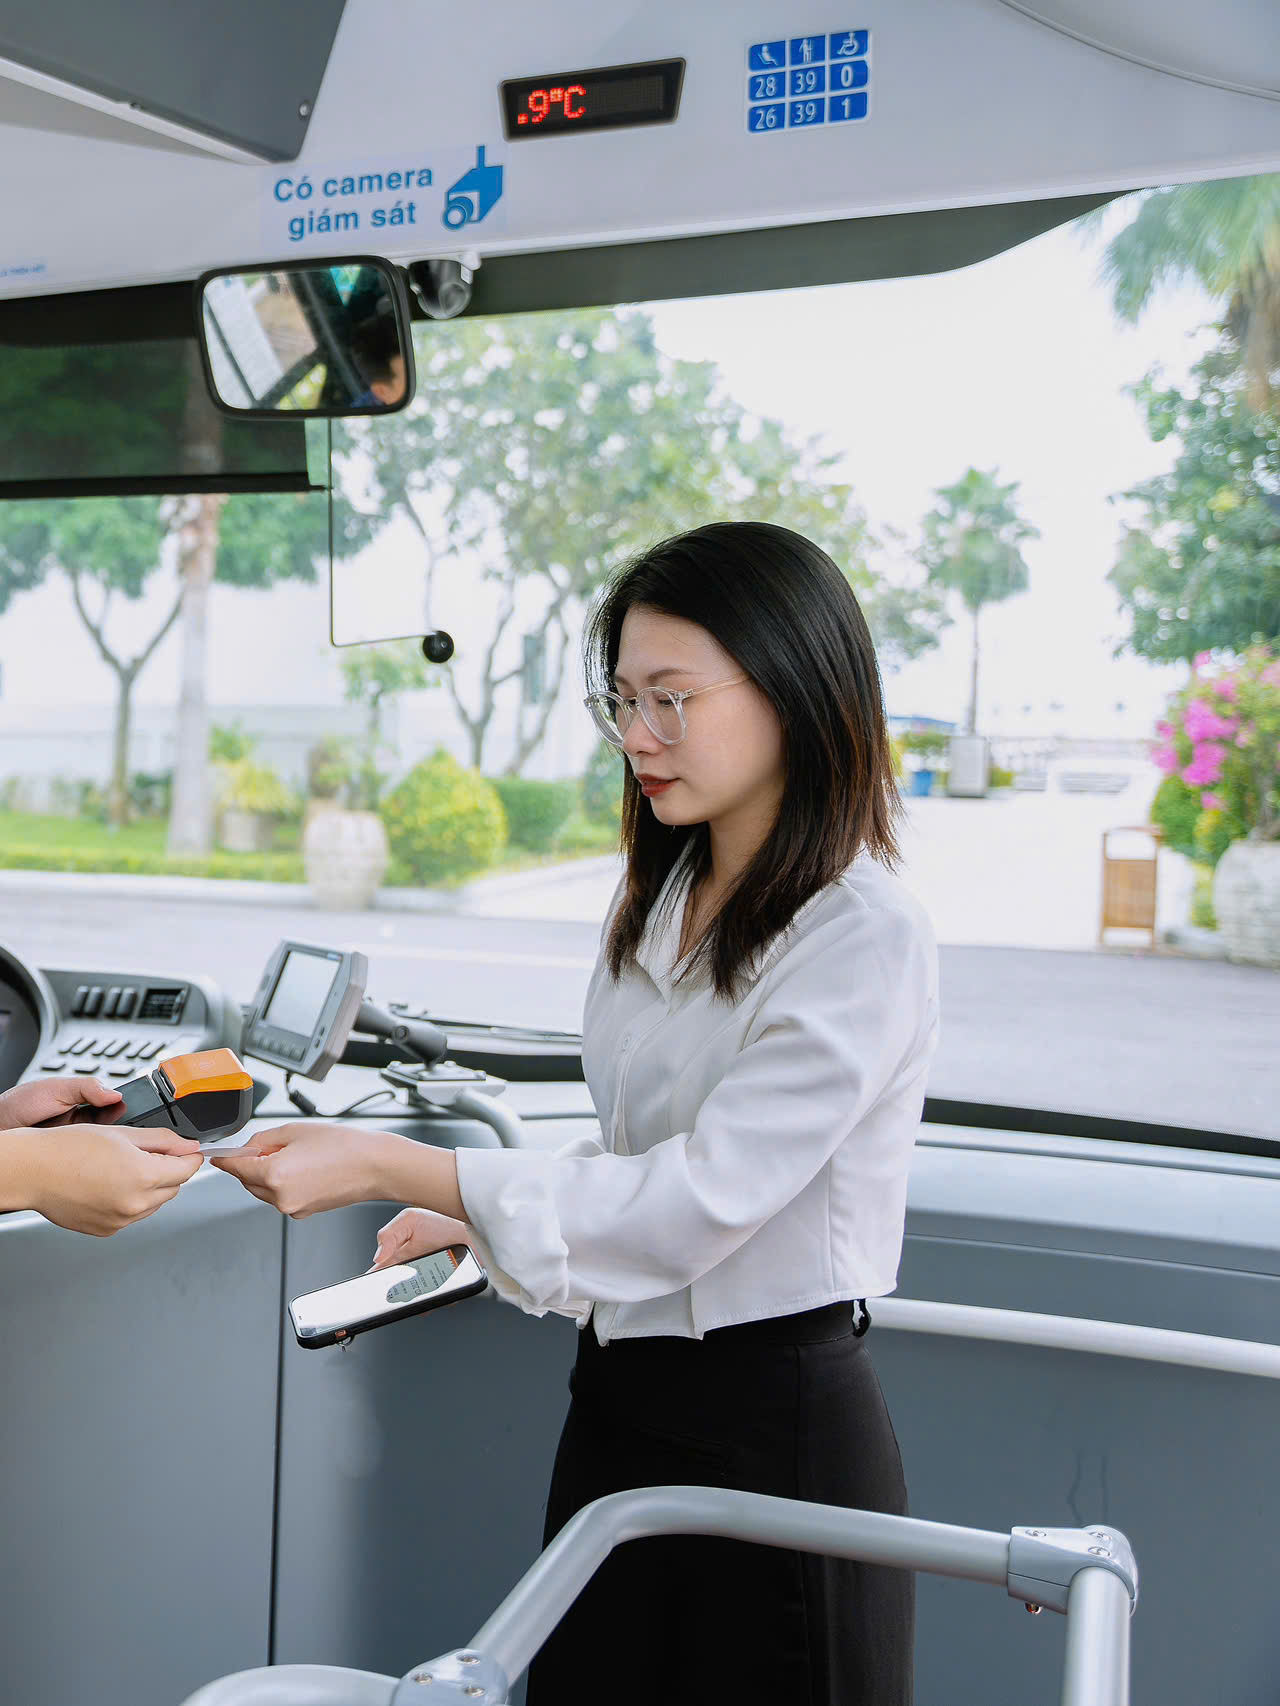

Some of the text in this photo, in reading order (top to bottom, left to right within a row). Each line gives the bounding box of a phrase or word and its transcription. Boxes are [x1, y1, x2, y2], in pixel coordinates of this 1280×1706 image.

[754, 64, 853, 98] 28 39 0
[754, 96, 850, 130] 26 39 1
[273, 167, 434, 202] Có camera
[288, 200, 417, 242] giám sát
